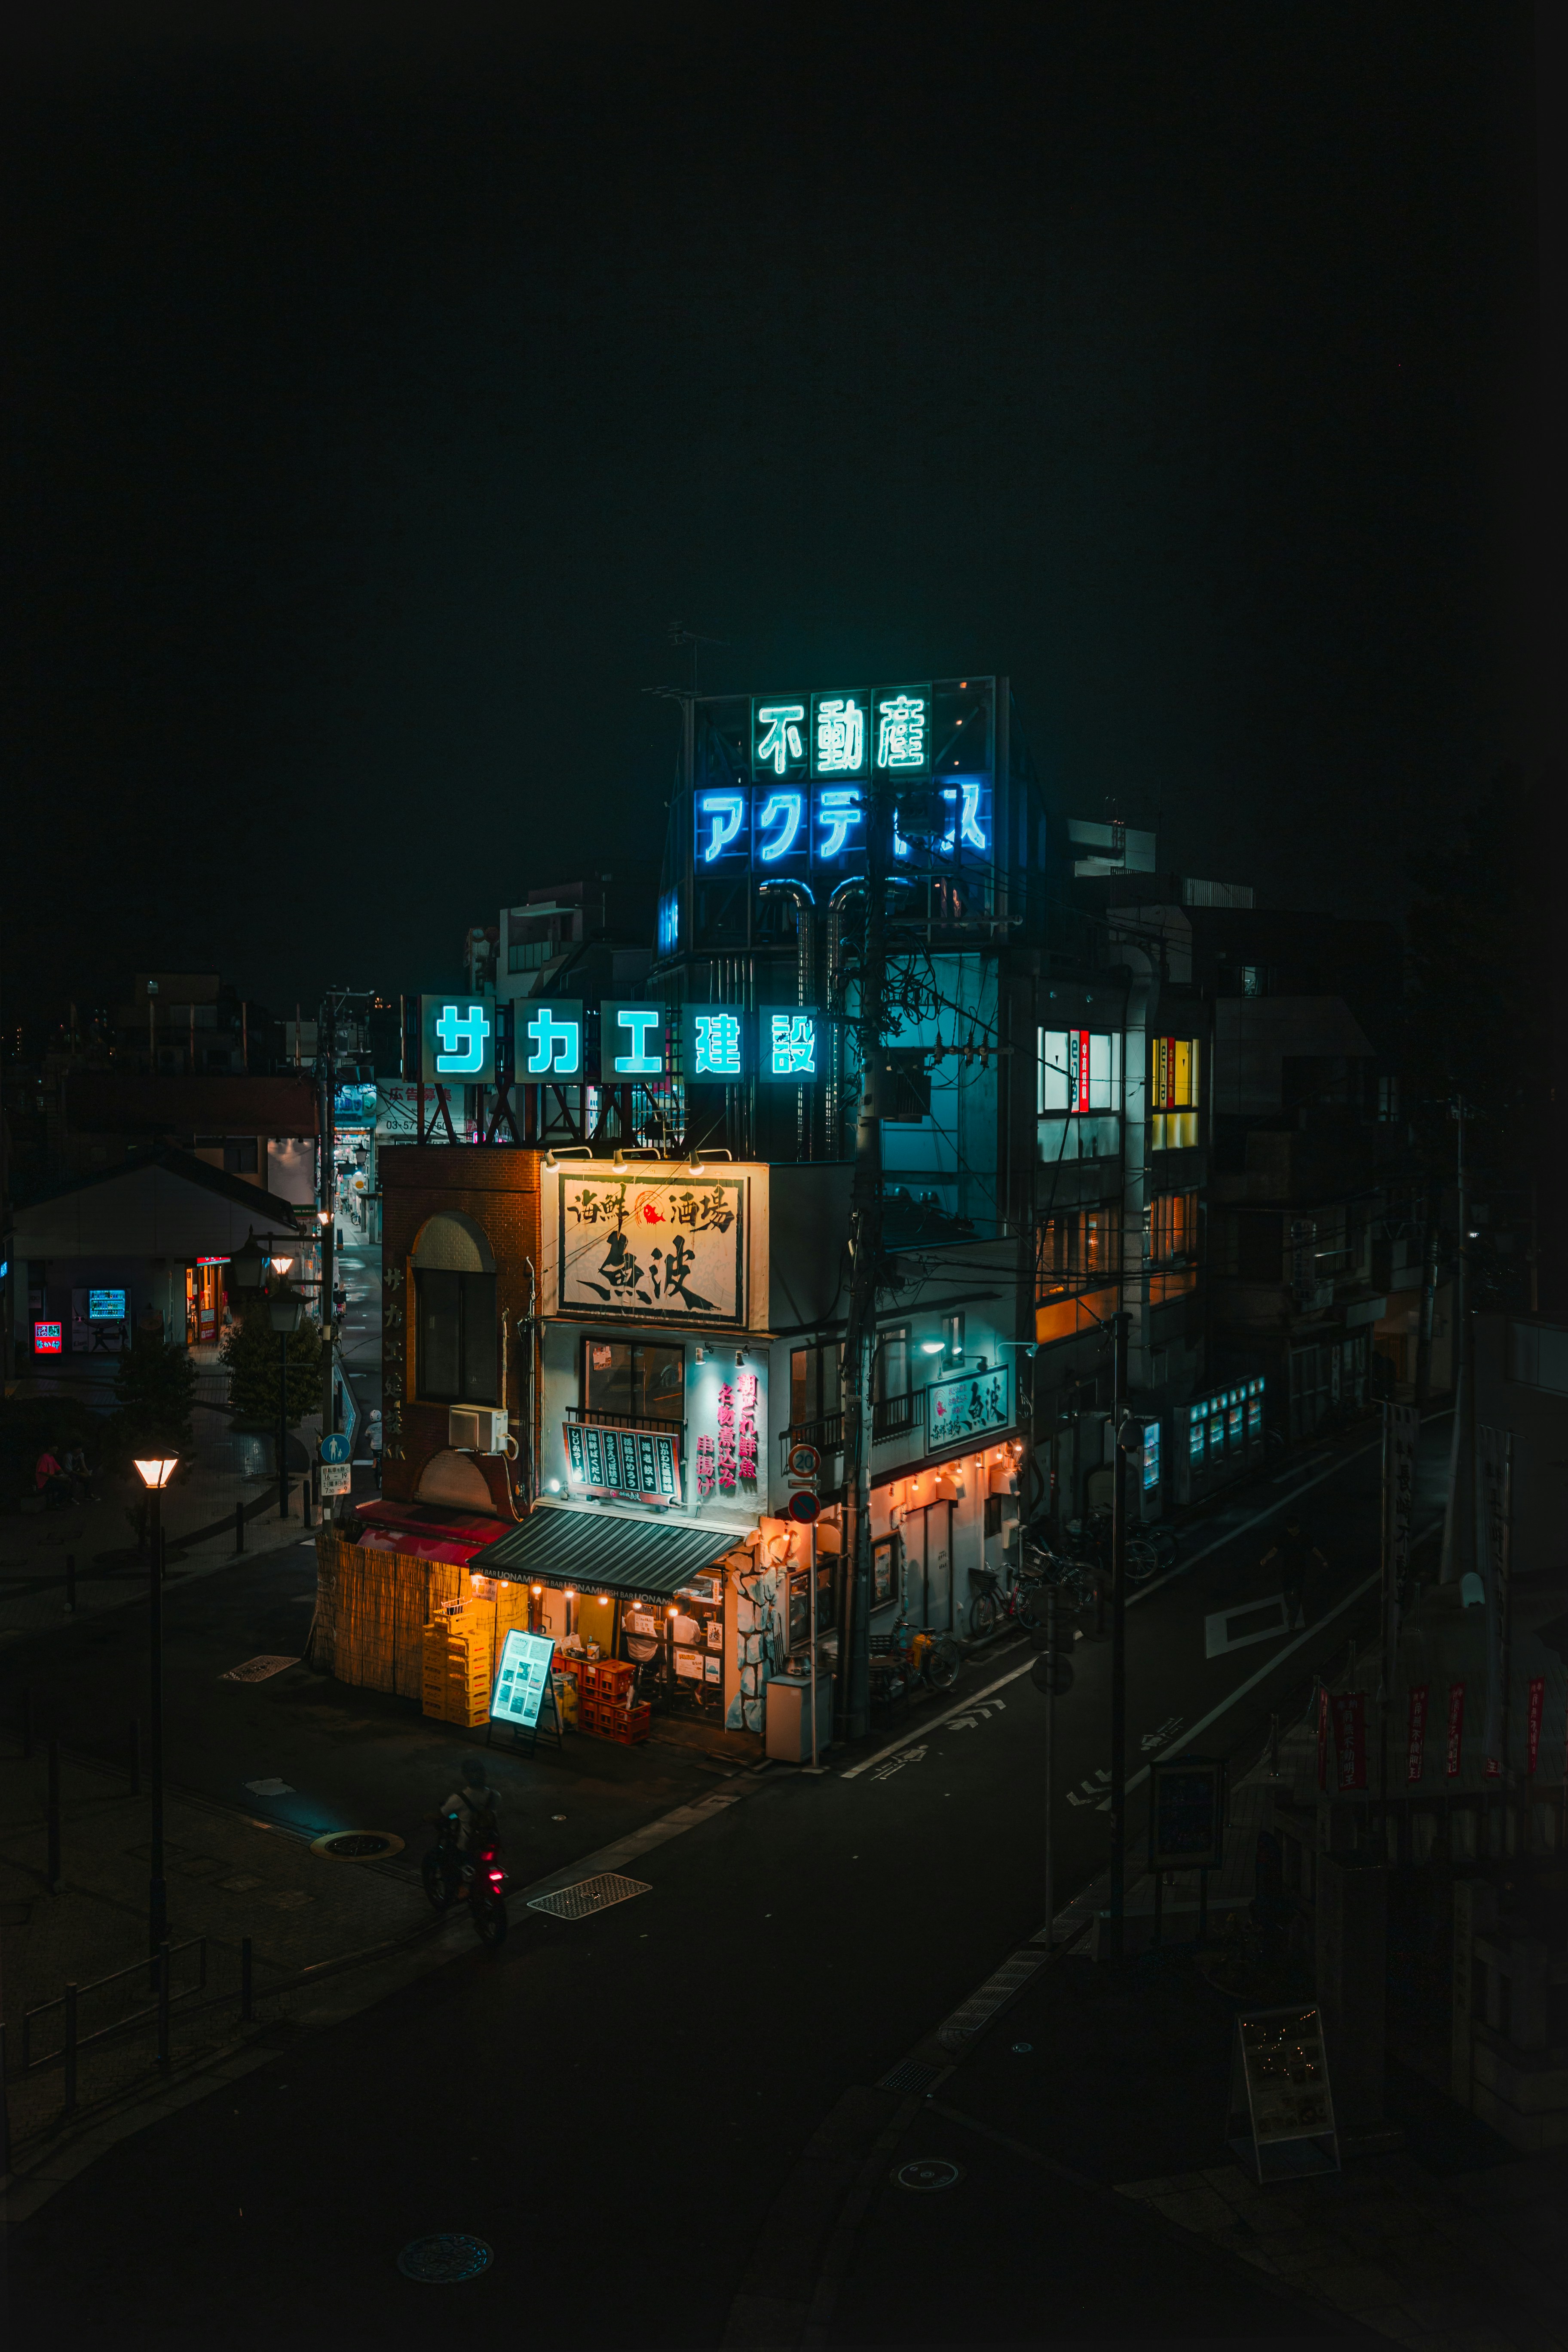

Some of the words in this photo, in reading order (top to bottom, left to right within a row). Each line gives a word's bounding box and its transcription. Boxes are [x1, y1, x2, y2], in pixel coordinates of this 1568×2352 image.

[758, 695, 925, 774] 不動産
[702, 784, 986, 862] アクテス
[436, 1005, 815, 1074] サカエ建設
[567, 1182, 630, 1240] 海鮮
[668, 1185, 735, 1233] 酒場
[576, 1230, 722, 1310] 魚波
[571, 1430, 583, 1479] しじみラーメ
[717, 1382, 737, 1488] 名物煮込み
[737, 1373, 758, 1479] 朝どれ鮮魚
[696, 1434, 716, 1497] 串揚げ
[796, 1454, 814, 1469] 20
[497, 1571, 533, 1583] UONAMI
[551, 1580, 563, 1588] BAR
[564, 1581, 602, 1595] UONAMI
[604, 1589, 619, 1597] FISH
[620, 1591, 633, 1599] BAR
